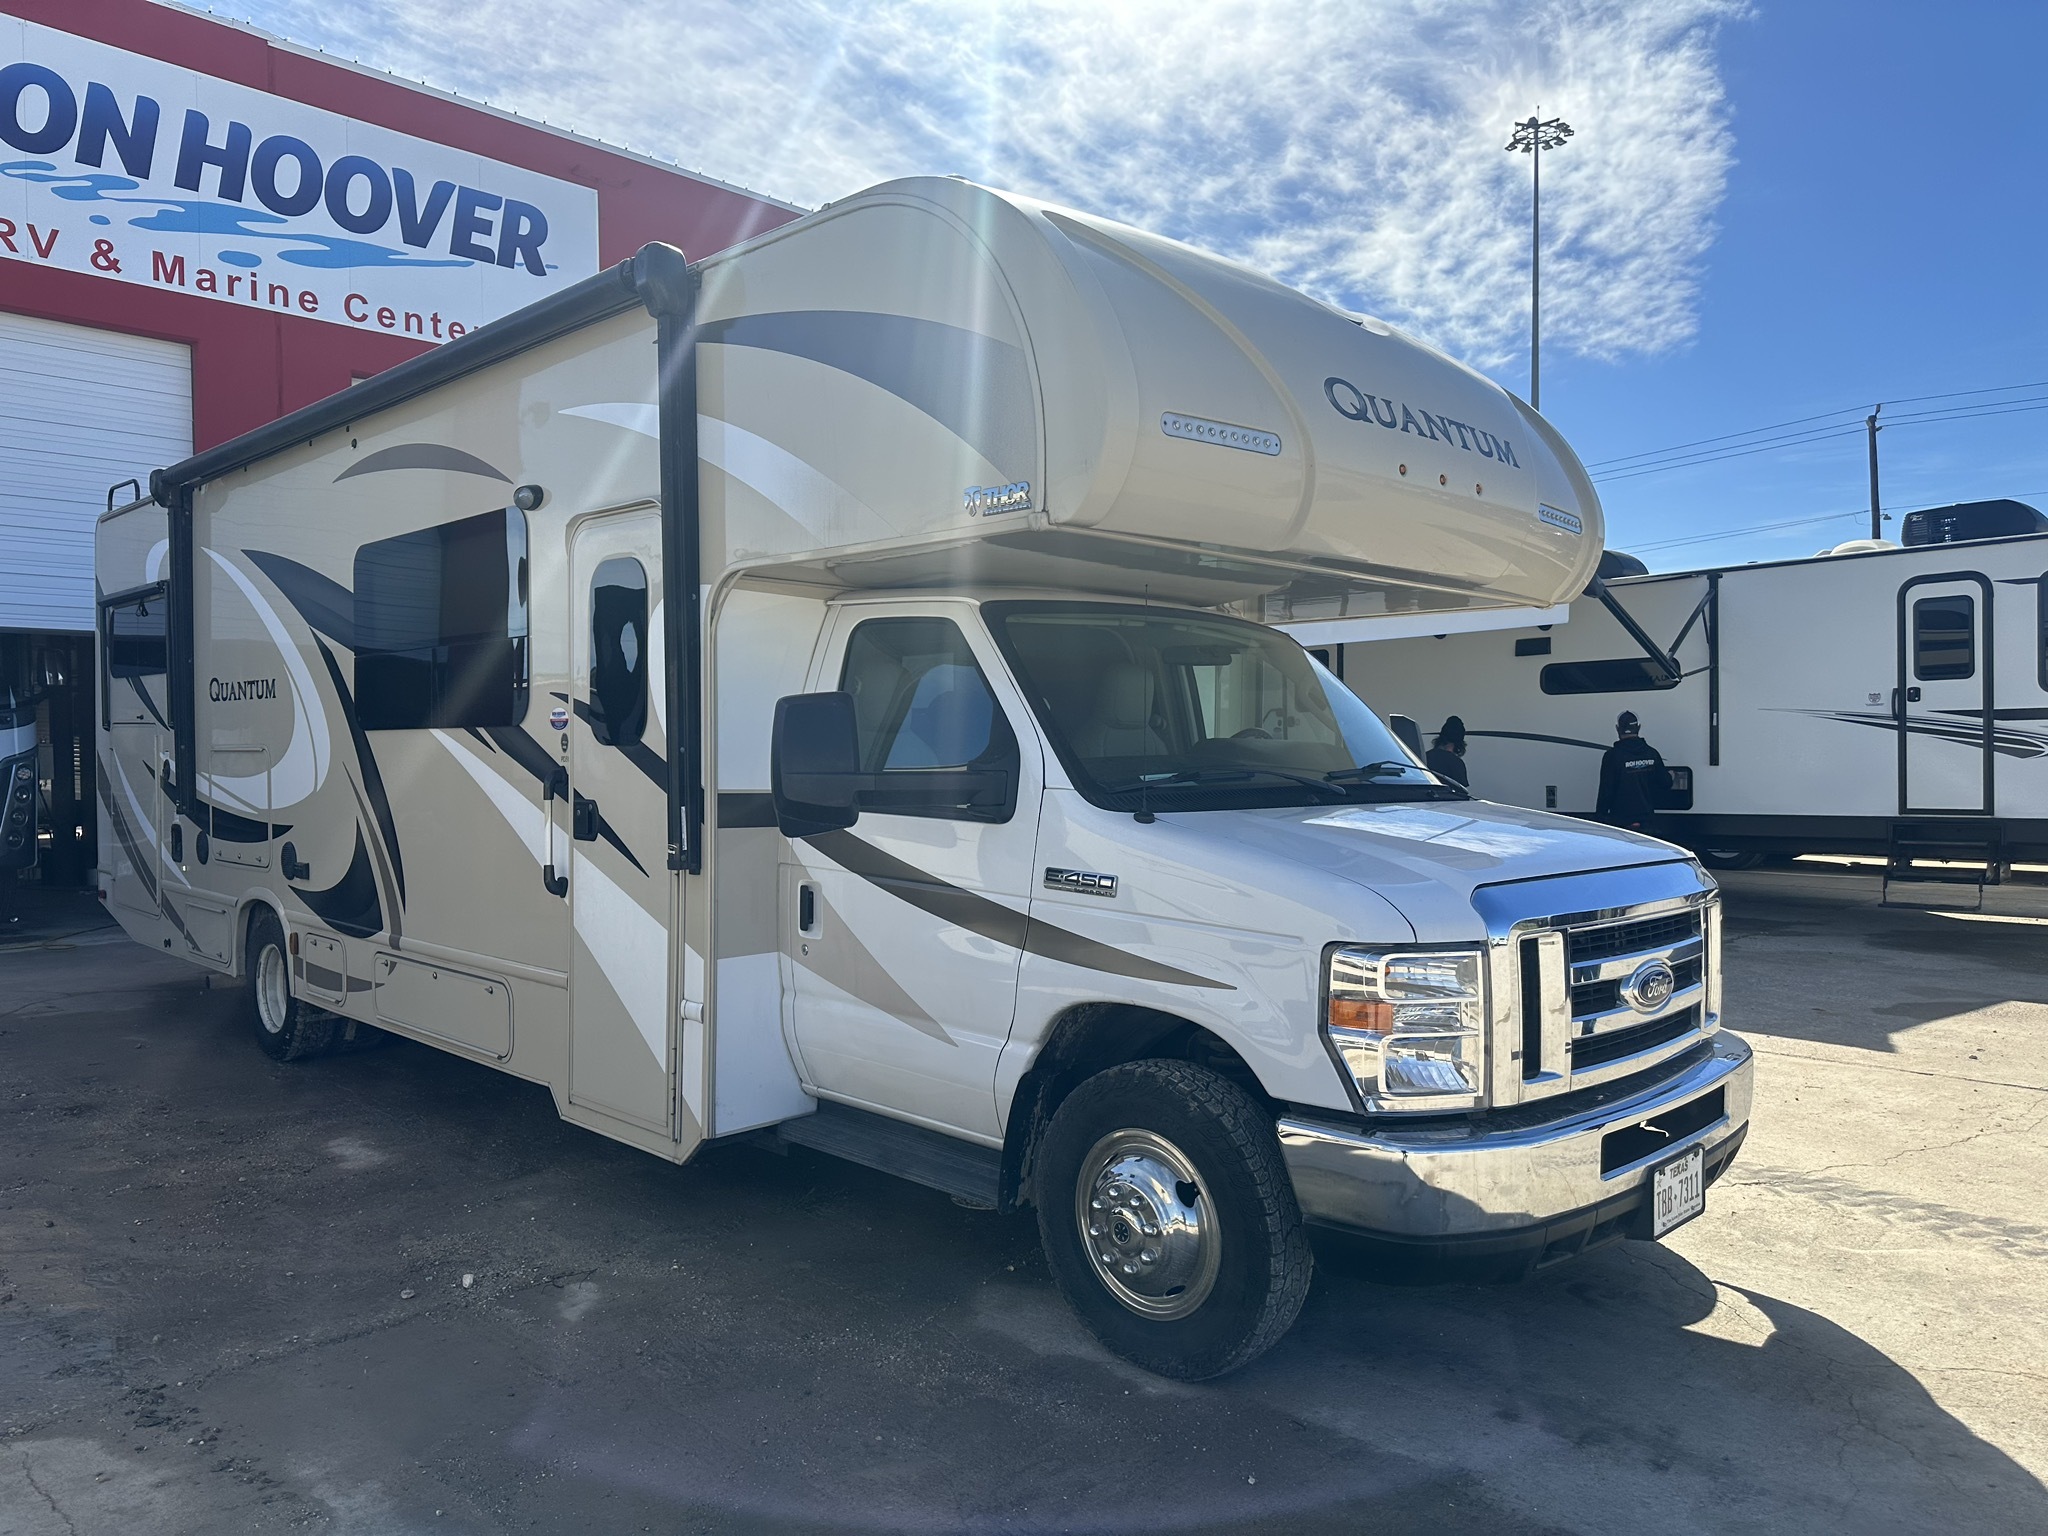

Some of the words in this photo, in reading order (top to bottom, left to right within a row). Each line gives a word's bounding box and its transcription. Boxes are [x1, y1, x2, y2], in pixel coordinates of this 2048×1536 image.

[0, 62, 160, 181] ON
[174, 108, 548, 277] HOOVER
[0, 217, 60, 260] RV
[90, 238, 122, 275] &
[152, 250, 319, 313] Marine
[343, 293, 480, 342] Cente
[1323, 376, 1521, 469] QUANTUM
[982, 480, 1032, 509] THOR
[209, 677, 277, 703] QUANTUM
[1045, 868, 1115, 890] E-450
[1647, 974, 1672, 998] Ford
[1669, 1160, 1689, 1180] TEXAS
